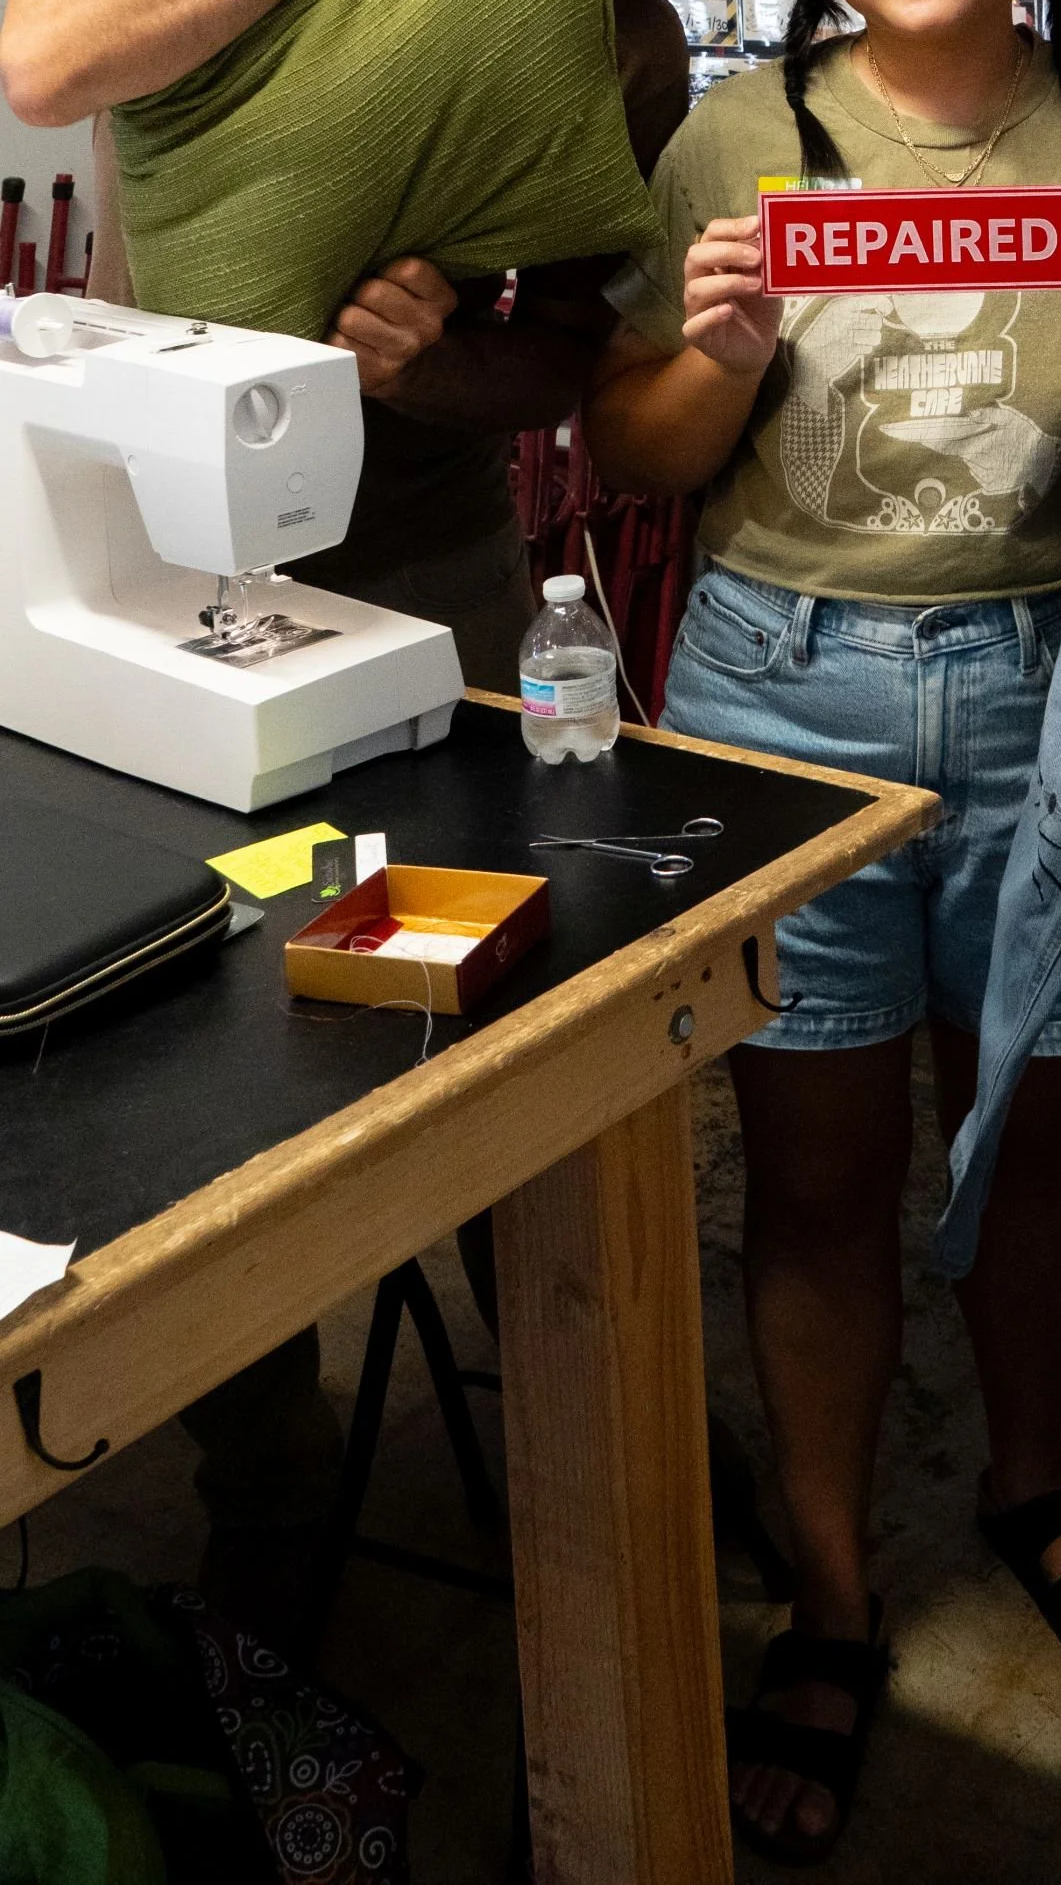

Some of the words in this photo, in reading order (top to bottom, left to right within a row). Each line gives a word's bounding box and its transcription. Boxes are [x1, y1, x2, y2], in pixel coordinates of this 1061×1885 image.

[784, 217, 1059, 268] REPAIRED
[874, 350, 1003, 390] WEATHERVANE
[910, 387, 963, 417] CAFE
